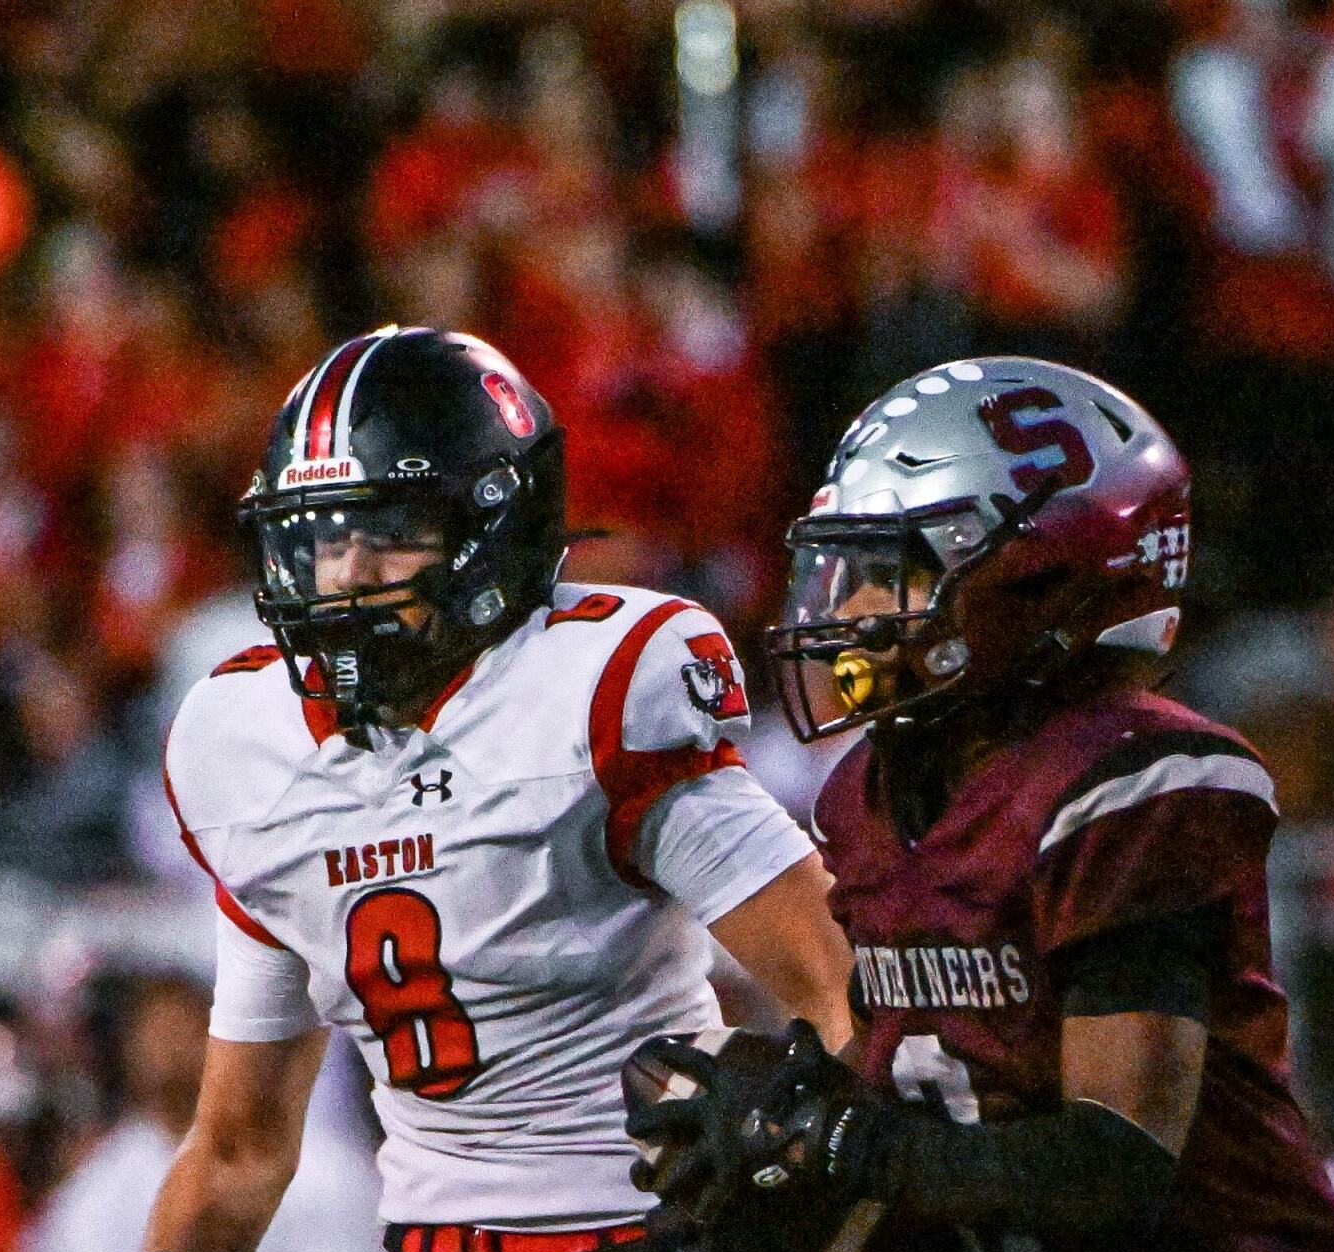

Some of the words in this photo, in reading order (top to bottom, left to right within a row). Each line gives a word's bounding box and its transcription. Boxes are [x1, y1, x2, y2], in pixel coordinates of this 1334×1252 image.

[285, 461, 352, 485] Riddell
[979, 386, 1096, 494] S
[324, 833, 435, 887] EASTON
[344, 887, 484, 1099] 8
